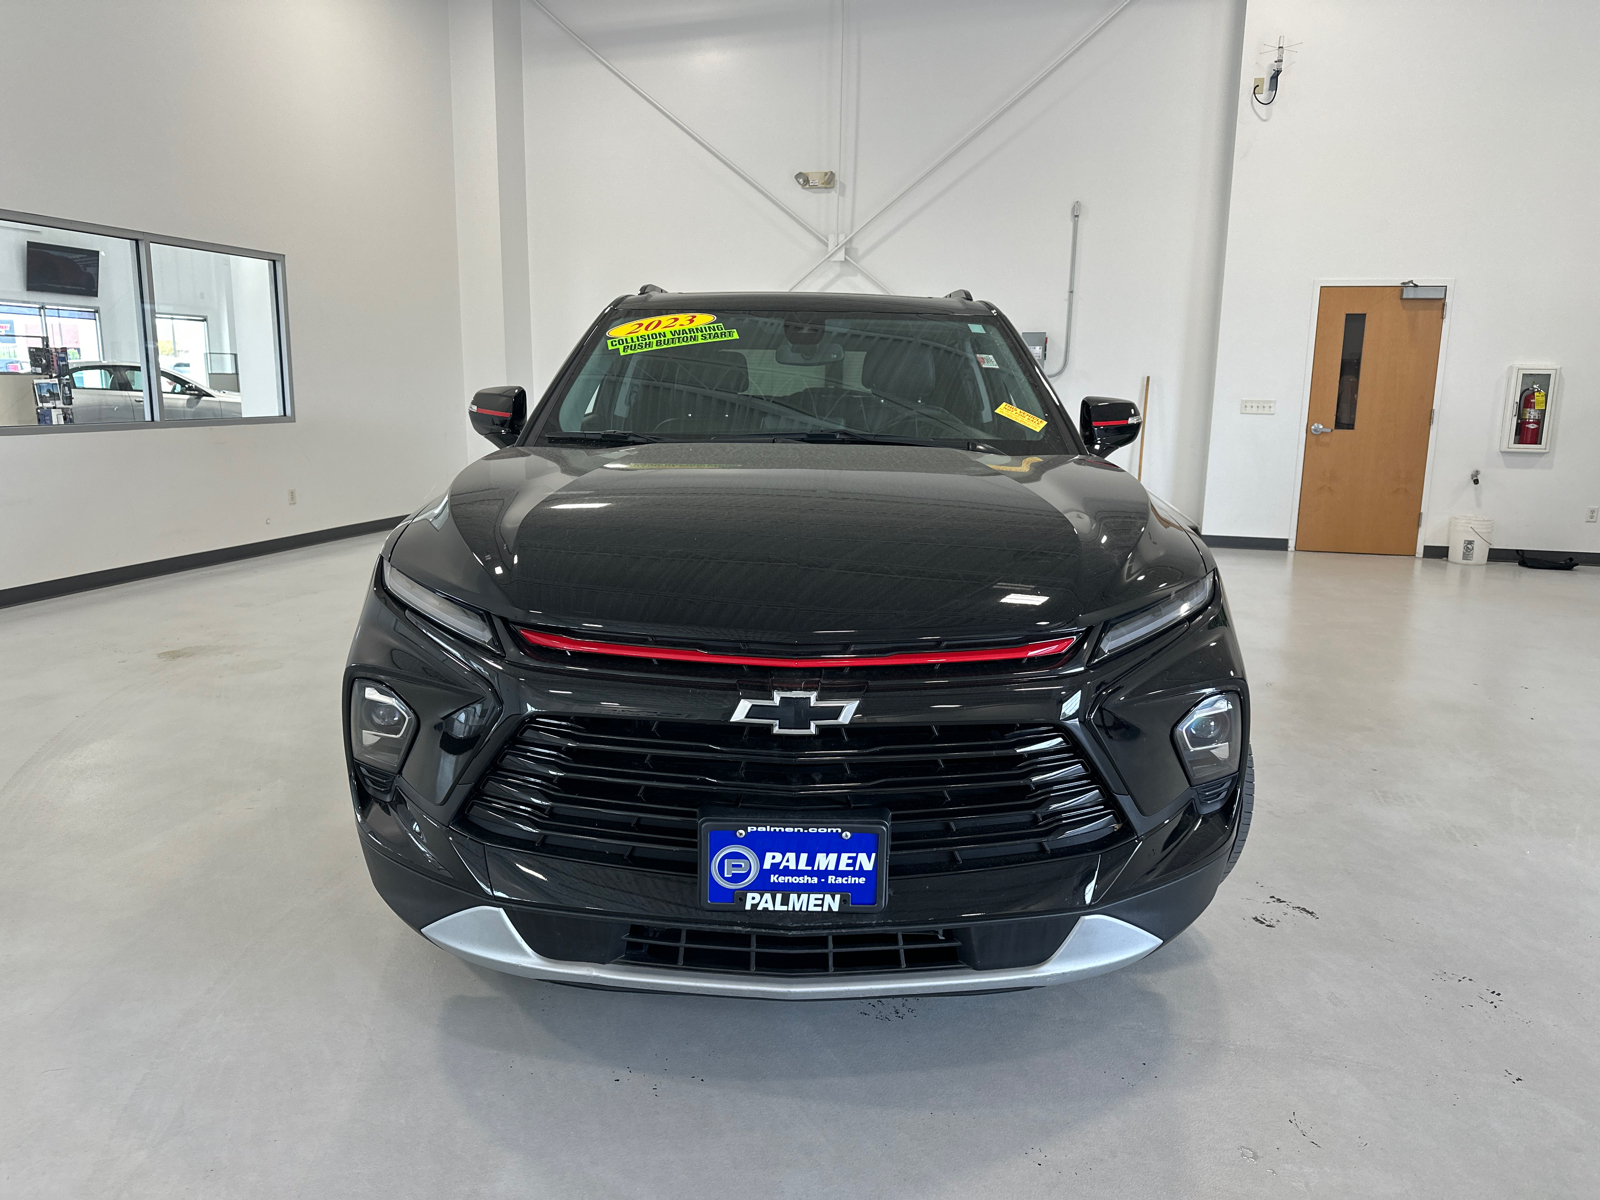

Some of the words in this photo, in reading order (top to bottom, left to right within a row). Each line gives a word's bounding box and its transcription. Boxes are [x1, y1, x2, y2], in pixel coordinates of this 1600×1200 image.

[625, 315, 697, 335] 2023
[610, 332, 667, 347] COLLISION
[670, 324, 724, 337] WARNING
[622, 341, 653, 353] PUSH
[655, 334, 699, 347] BUTTON
[701, 330, 735, 341] START
[747, 825, 842, 833] palmen.com
[762, 851, 876, 871] PALMEN
[770, 874, 818, 884] Kenosha
[827, 875, 866, 884] Racine
[745, 892, 841, 912] PALMEN
